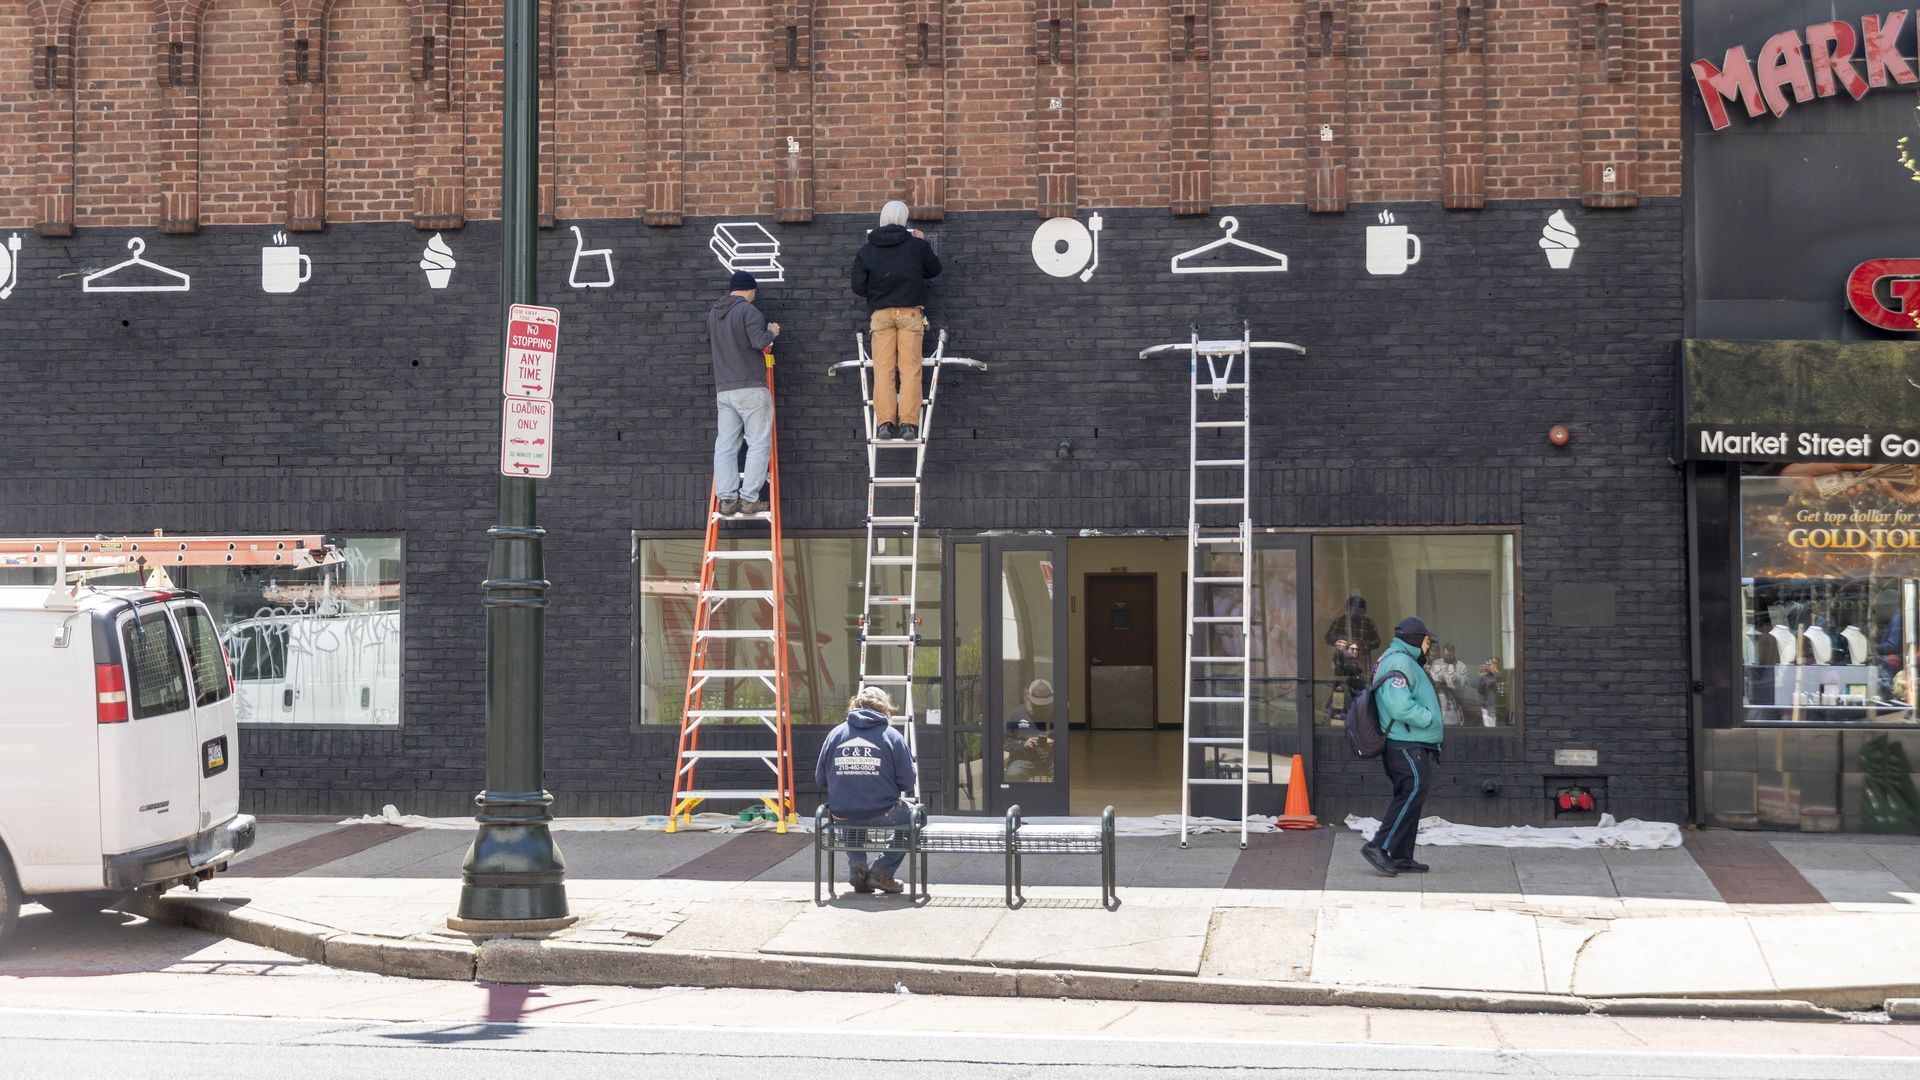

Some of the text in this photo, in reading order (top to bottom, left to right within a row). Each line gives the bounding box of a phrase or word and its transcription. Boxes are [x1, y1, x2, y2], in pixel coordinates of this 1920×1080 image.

[1689, 9, 1920, 131] MARK
[526, 324, 539, 336] NO
[512, 334, 552, 349] STOPPING
[520, 352, 542, 366] ANY
[518, 366, 542, 381] TIME
[511, 403, 546, 415] LOADING
[517, 418, 538, 430] ONLY
[1700, 430, 1789, 455] Market
[1797, 432, 1872, 457] Street
[1796, 509, 1821, 523] Get
[1824, 510, 1846, 525] top
[1849, 509, 1890, 523] dollar
[1892, 509, 1914, 525] for
[1787, 528, 1867, 549] GOLD
[842, 747, 872, 756] C & R
